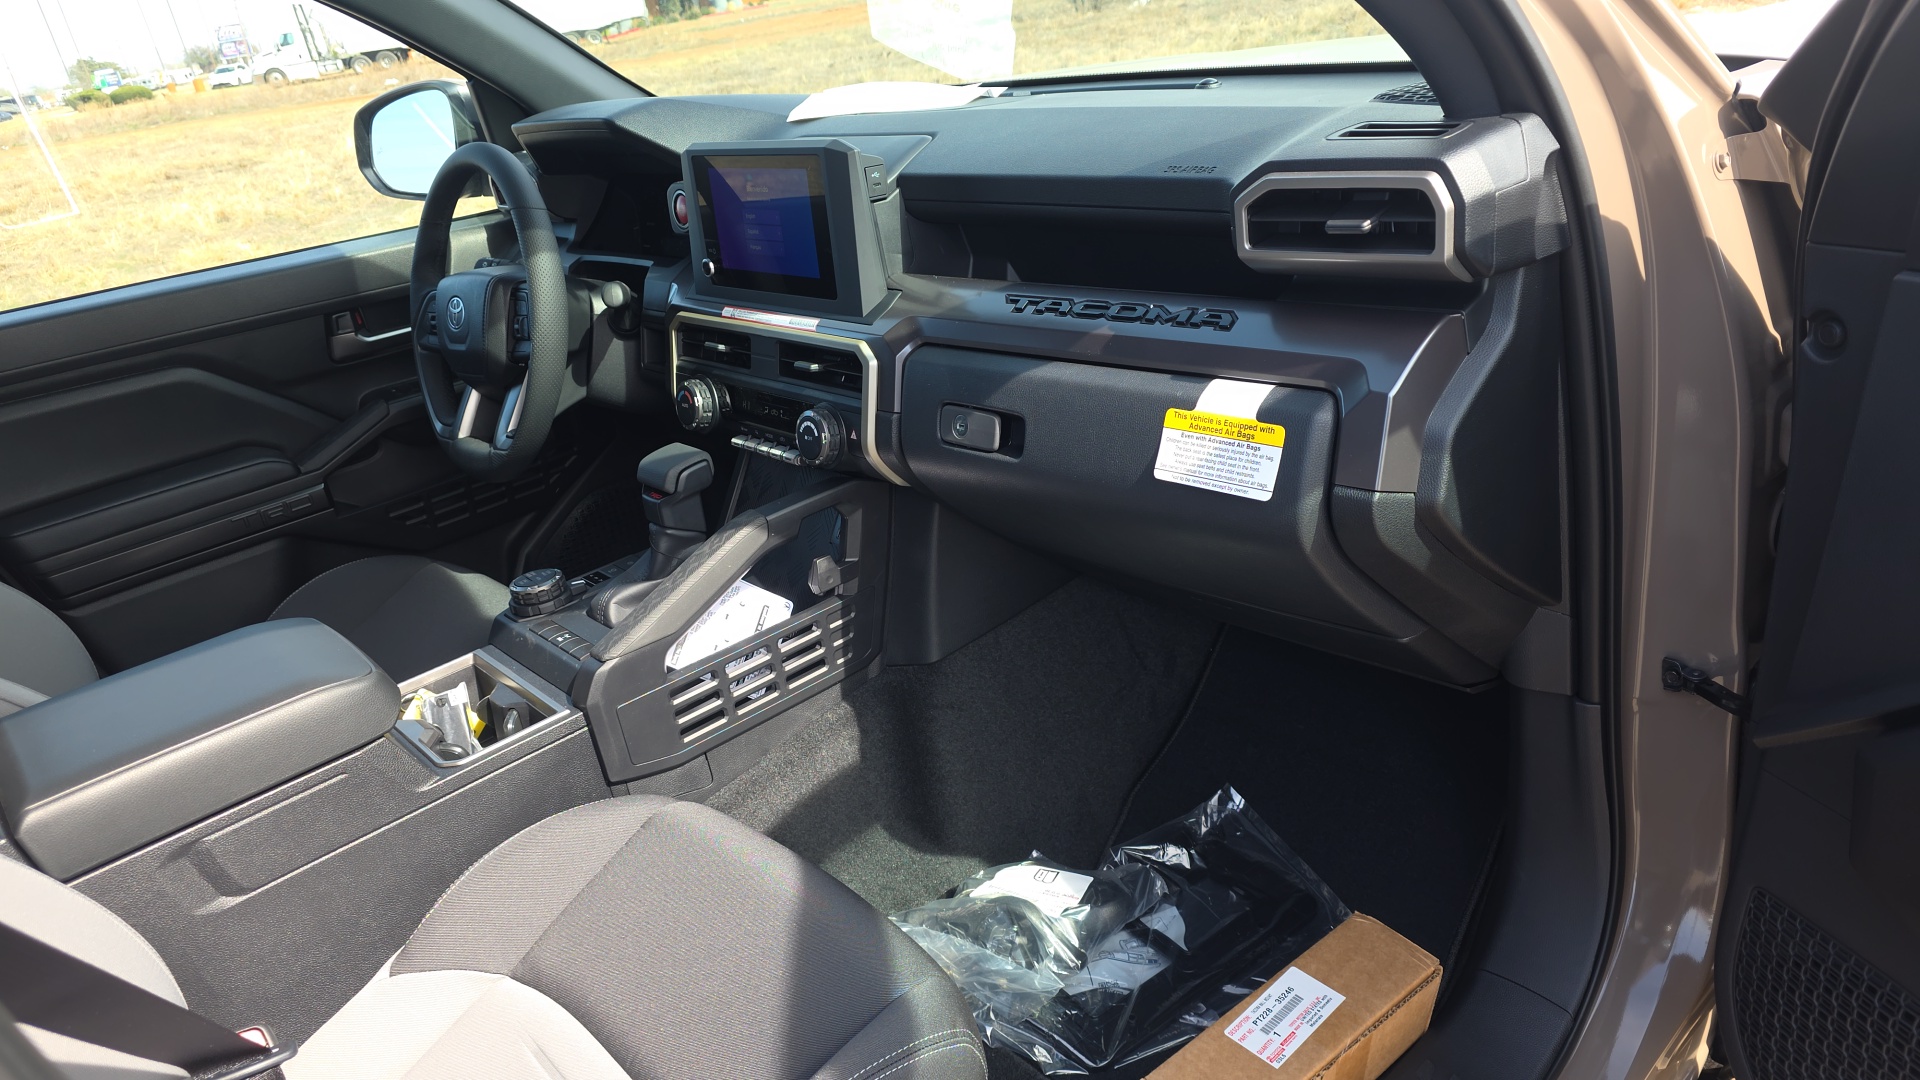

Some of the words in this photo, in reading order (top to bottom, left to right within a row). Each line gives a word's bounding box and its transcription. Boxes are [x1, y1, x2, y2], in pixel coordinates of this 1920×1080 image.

[1005, 294, 1239, 332] TACOMA
[1189, 423, 1223, 434] Advanced
[1237, 431, 1255, 441] Bags
[1190, 414, 1214, 424] Vehicle
[1224, 420, 1258, 434] Equipped
[1260, 426, 1276, 434] with
[1208, 437, 1236, 446] Advanced
[1247, 444, 1261, 452] Bags
[1212, 483, 1227, 491] except
[230, 494, 314, 529] TRD
[1238, 1034, 1248, 1043] PART
[1257, 1038, 1275, 1055] QUANTITY:
